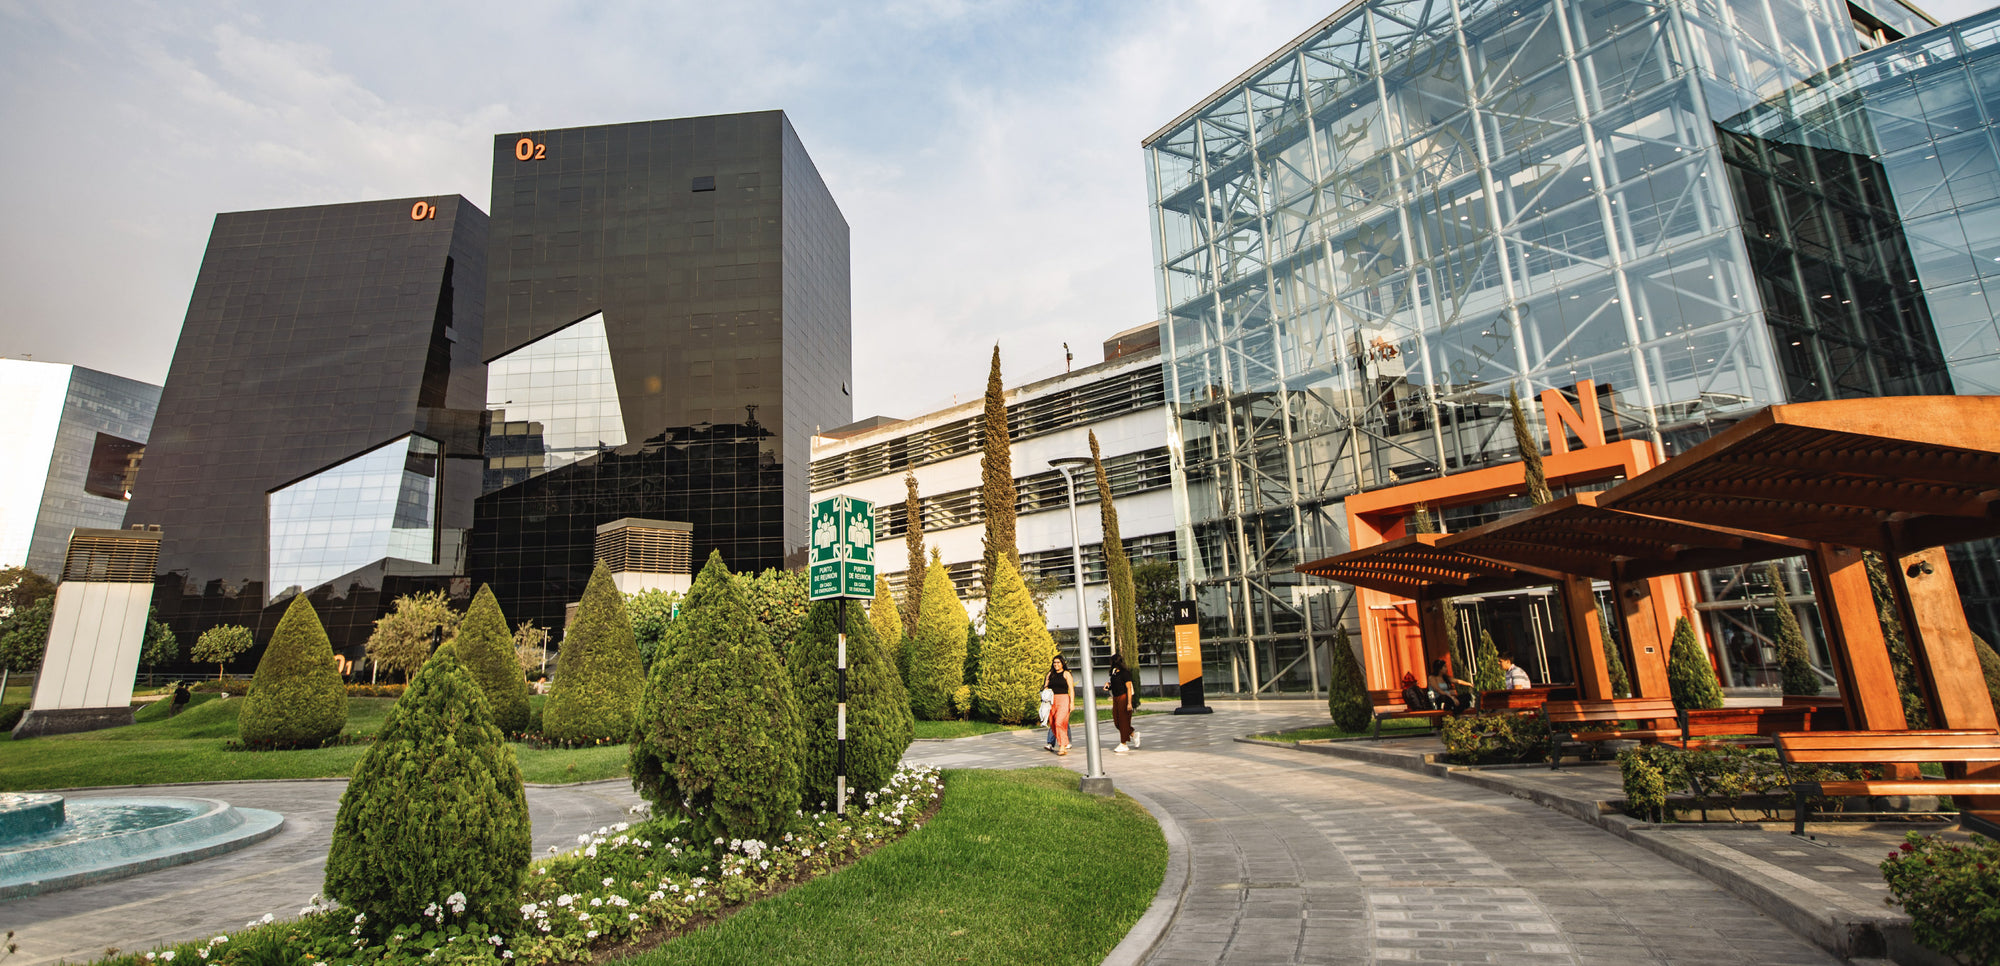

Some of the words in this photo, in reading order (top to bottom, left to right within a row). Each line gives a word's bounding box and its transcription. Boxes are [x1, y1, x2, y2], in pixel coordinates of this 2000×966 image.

[1403, 39, 1469, 82] DE
[1465, 59, 1563, 198] LIMA
[1434, 302, 1530, 393] PRAXIS
[1540, 379, 1606, 456] N
[1181, 608, 1189, 618] N
